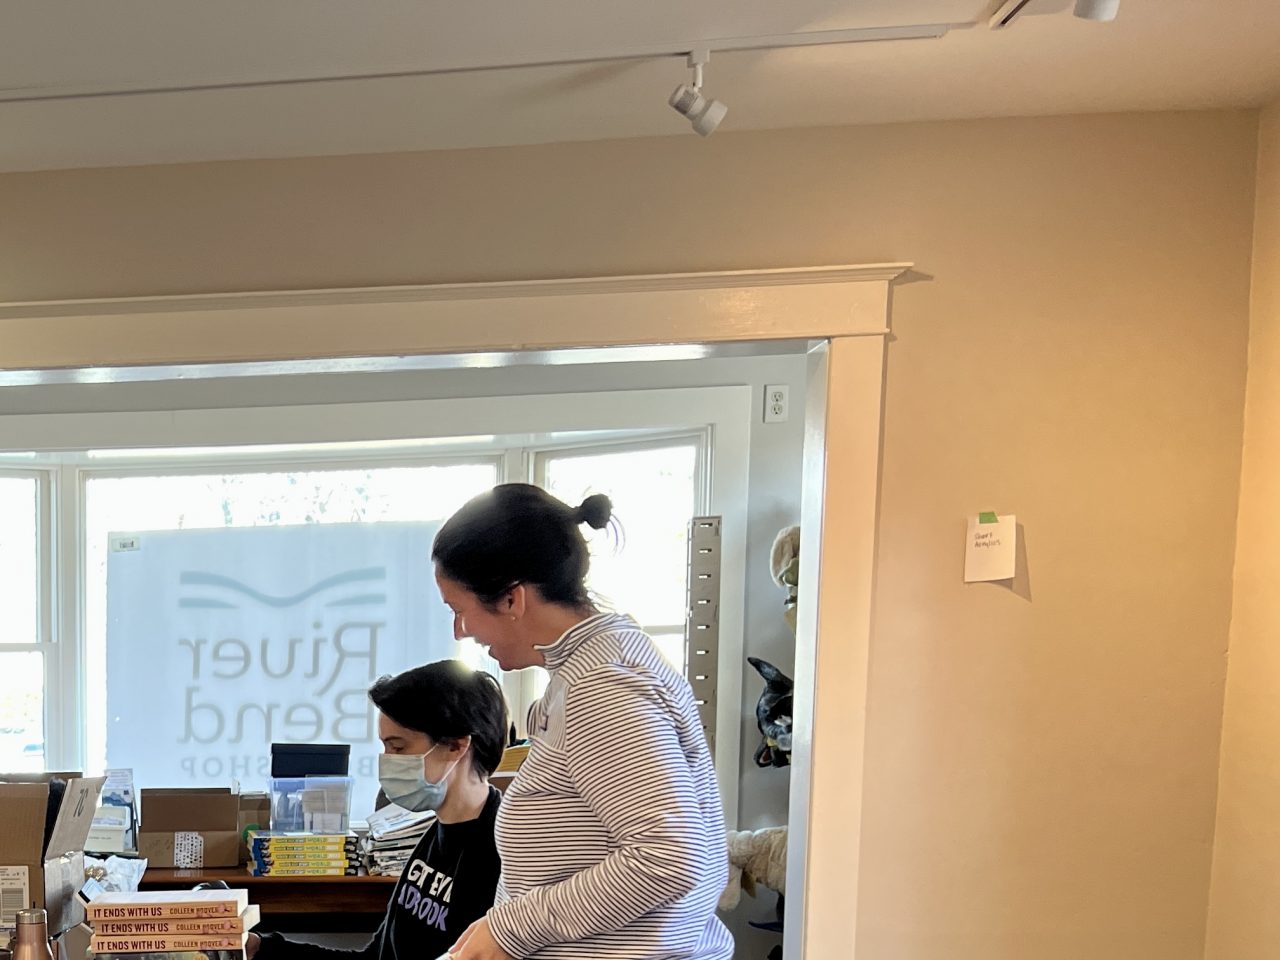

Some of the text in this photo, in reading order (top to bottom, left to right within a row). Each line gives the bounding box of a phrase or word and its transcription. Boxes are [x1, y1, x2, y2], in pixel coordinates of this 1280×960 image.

[94, 908, 101, 918] IT
[104, 908, 125, 918] ENDS
[127, 908, 149, 917] WITH
[151, 907, 162, 916] US
[102, 924, 108, 933] IT
[111, 924, 133, 933] ENDS
[135, 924, 156, 932] WITH
[158, 923, 169, 932] US
[98, 942, 105, 950] IT
[108, 941, 129, 950] ENDS
[131, 941, 153, 950] WITH
[155, 941, 166, 949] US
